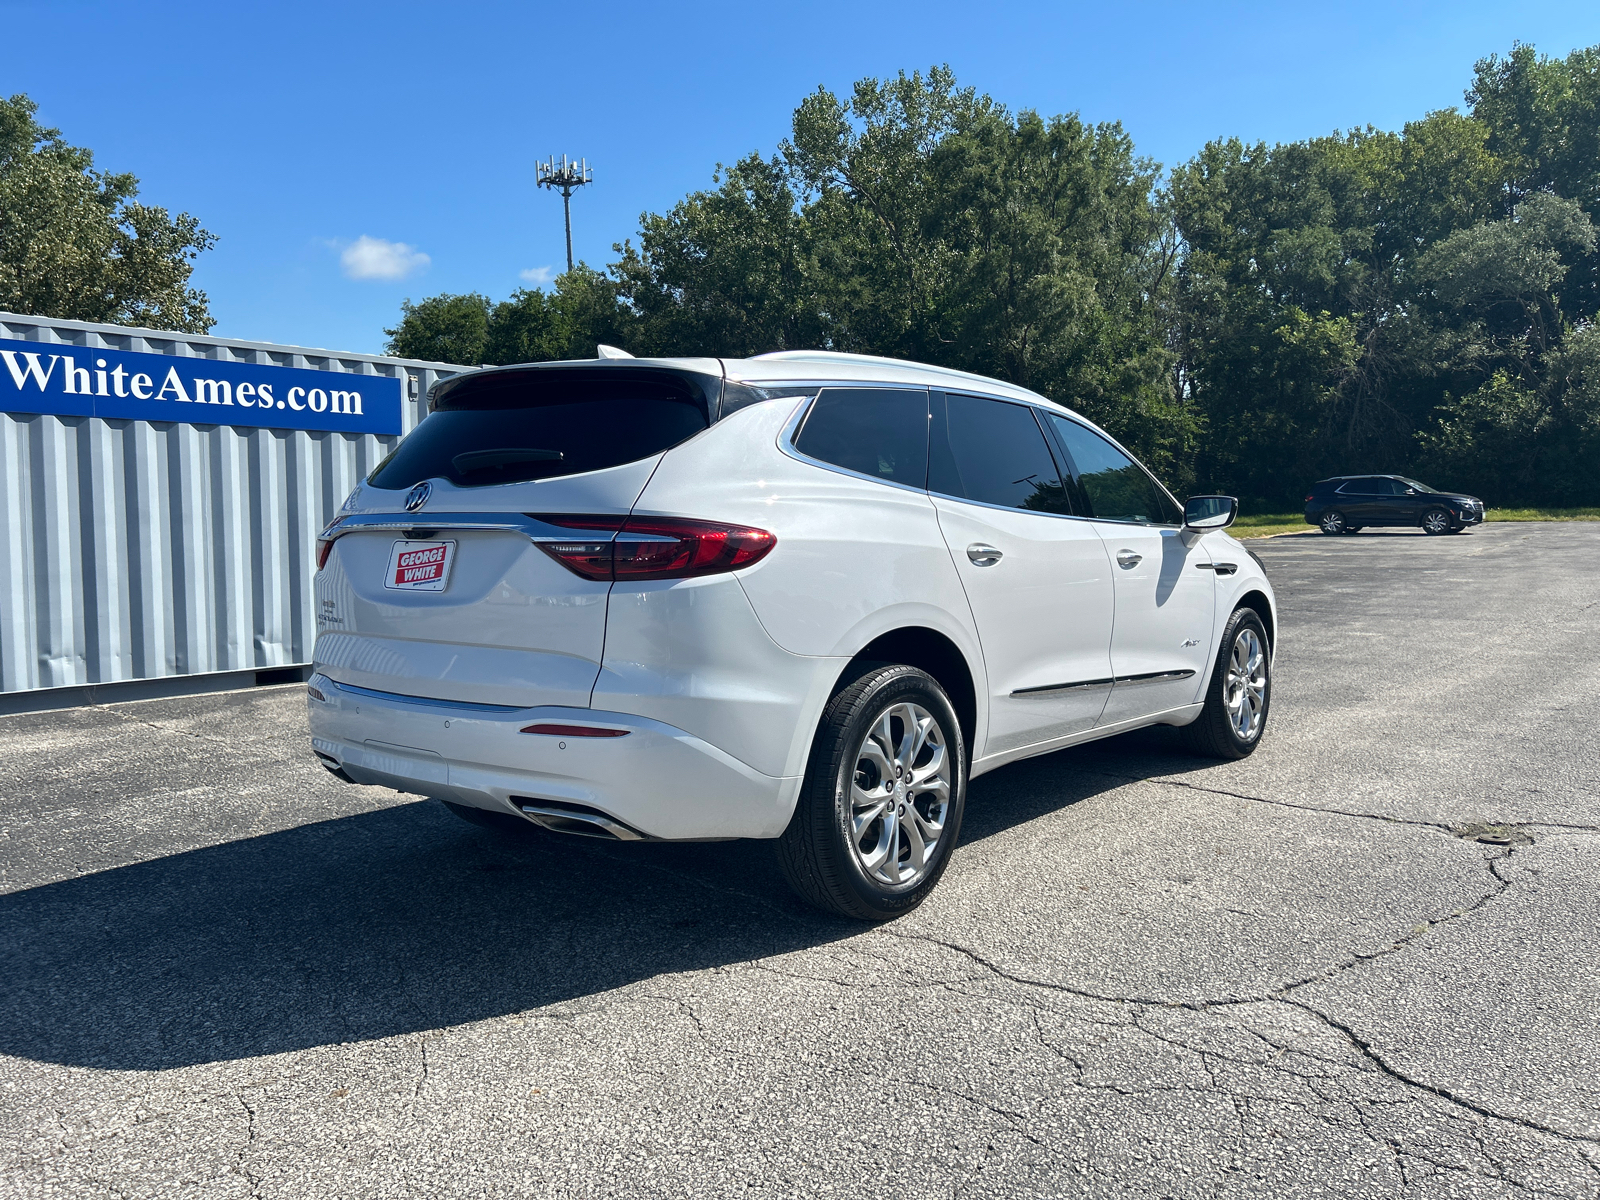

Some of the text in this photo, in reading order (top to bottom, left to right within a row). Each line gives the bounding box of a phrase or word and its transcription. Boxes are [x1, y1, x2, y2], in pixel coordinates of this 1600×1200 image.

[0, 350, 364, 415] WhiteAmes.com
[400, 547, 445, 567] GEORGE
[404, 564, 437, 582] WHITE
